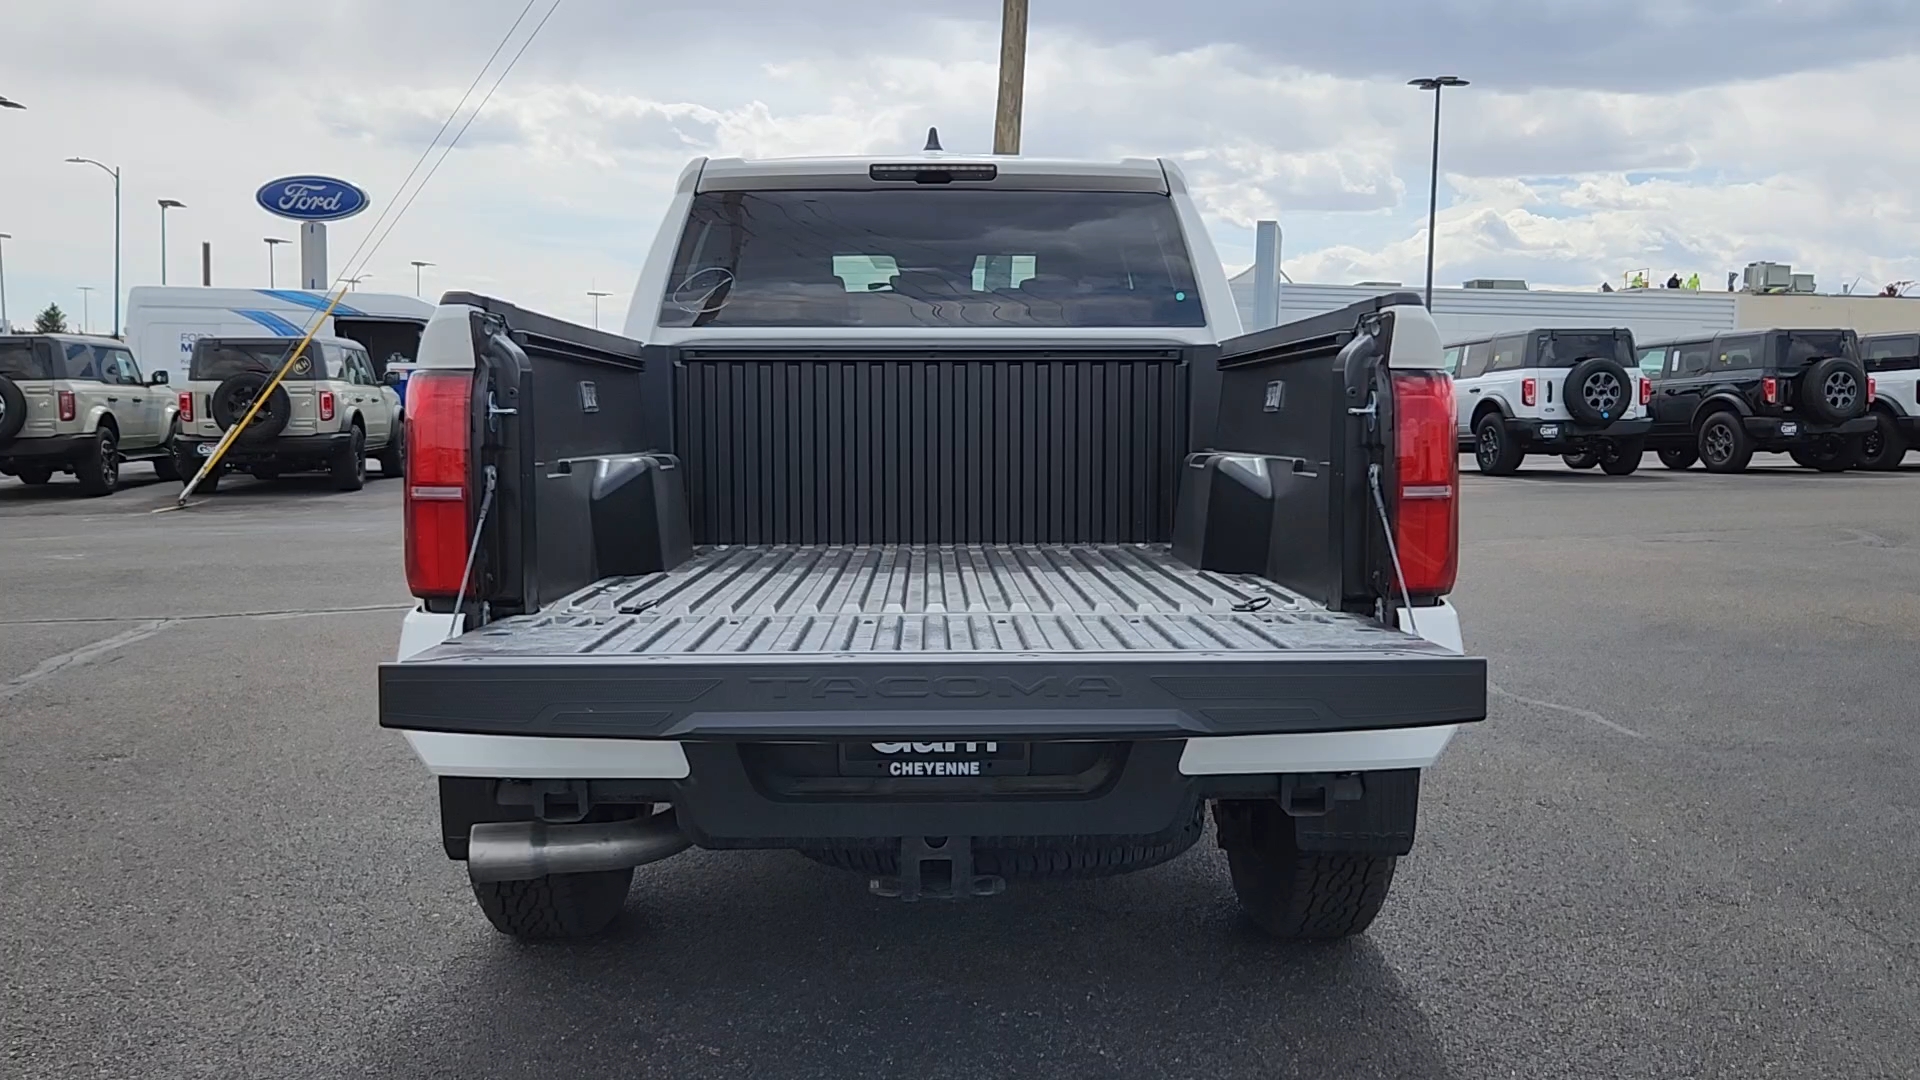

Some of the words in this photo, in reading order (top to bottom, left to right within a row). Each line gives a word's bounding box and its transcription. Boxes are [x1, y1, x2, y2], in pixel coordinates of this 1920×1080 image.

[278, 183, 342, 210] Ford
[746, 675, 1123, 699] TACOMA
[889, 761, 980, 776] CHEYENNE
